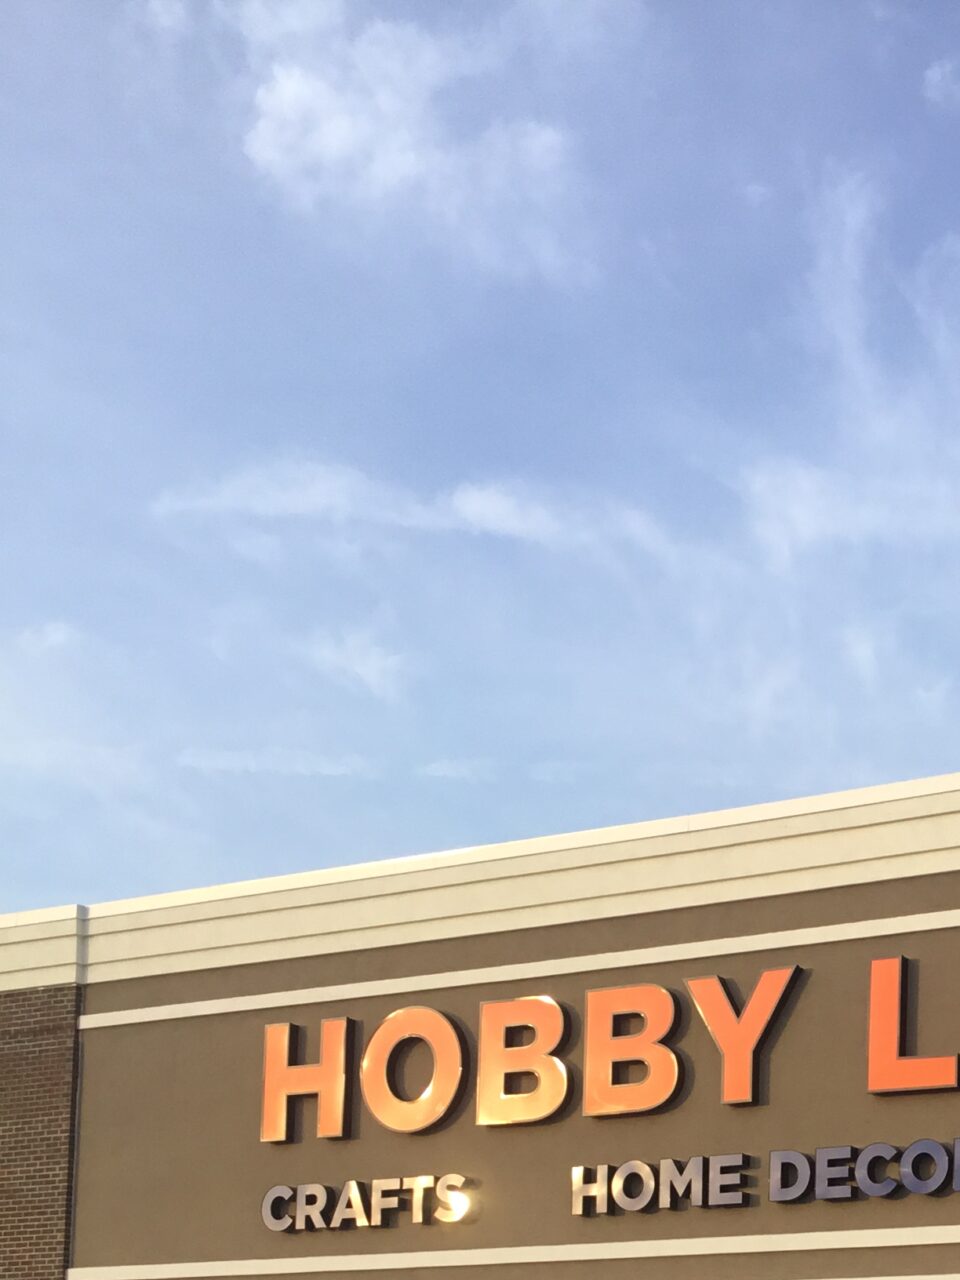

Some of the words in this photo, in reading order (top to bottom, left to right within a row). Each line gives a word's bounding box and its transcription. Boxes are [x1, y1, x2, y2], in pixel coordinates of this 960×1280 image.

[260, 965, 806, 1142] HOBBY
[261, 1173, 474, 1232] CRAFTS
[571, 1153, 748, 1216] HOME
